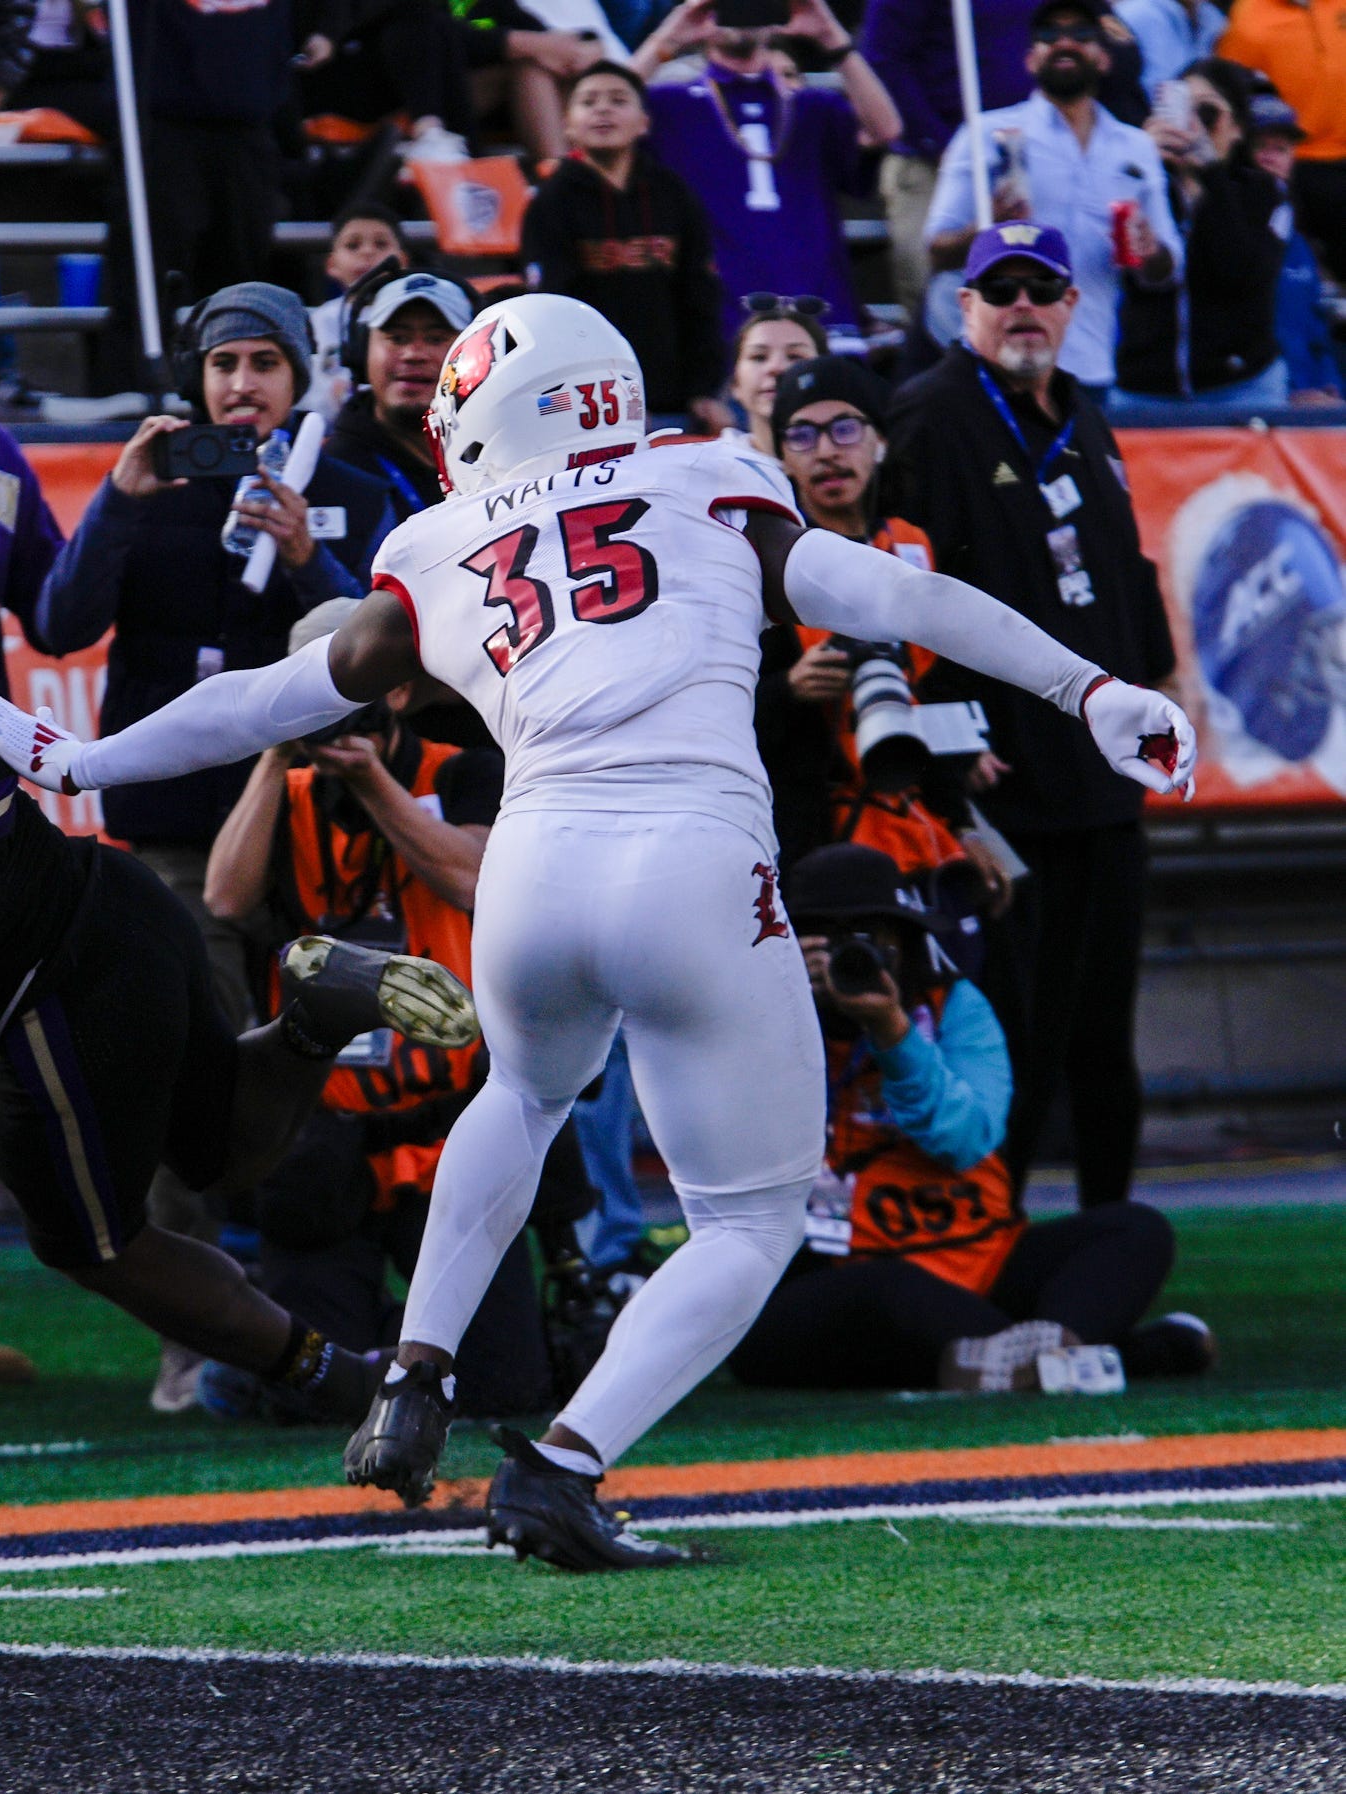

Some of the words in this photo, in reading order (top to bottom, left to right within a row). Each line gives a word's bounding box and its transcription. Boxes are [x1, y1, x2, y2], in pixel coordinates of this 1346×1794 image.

[574, 379, 620, 430] 35
[485, 458, 622, 522] WATTS
[457, 497, 659, 679] 35
